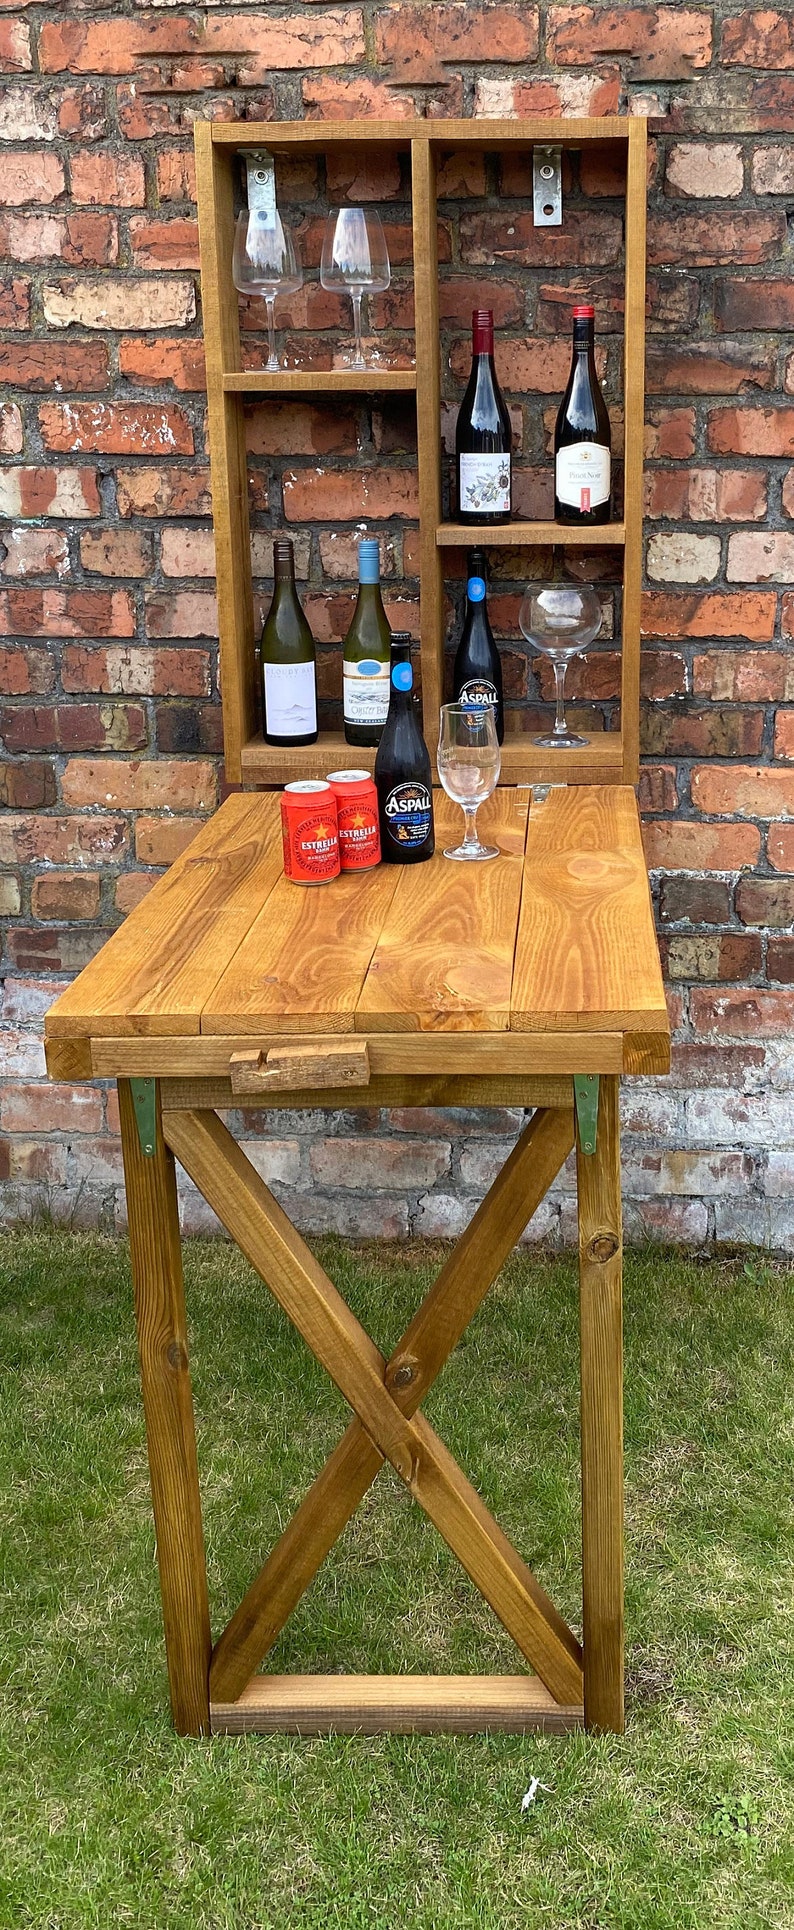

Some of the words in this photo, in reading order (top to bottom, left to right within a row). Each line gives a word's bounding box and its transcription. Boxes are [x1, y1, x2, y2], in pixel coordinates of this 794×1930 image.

[569, 471, 587, 479] Pinot
[587, 471, 602, 479] Noir
[458, 690, 499, 704] ASPALL
[385, 796, 431, 817] ASPALL
[339, 826, 377, 838] ESTRELLA
[301, 837, 338, 850] ESTRELLA
